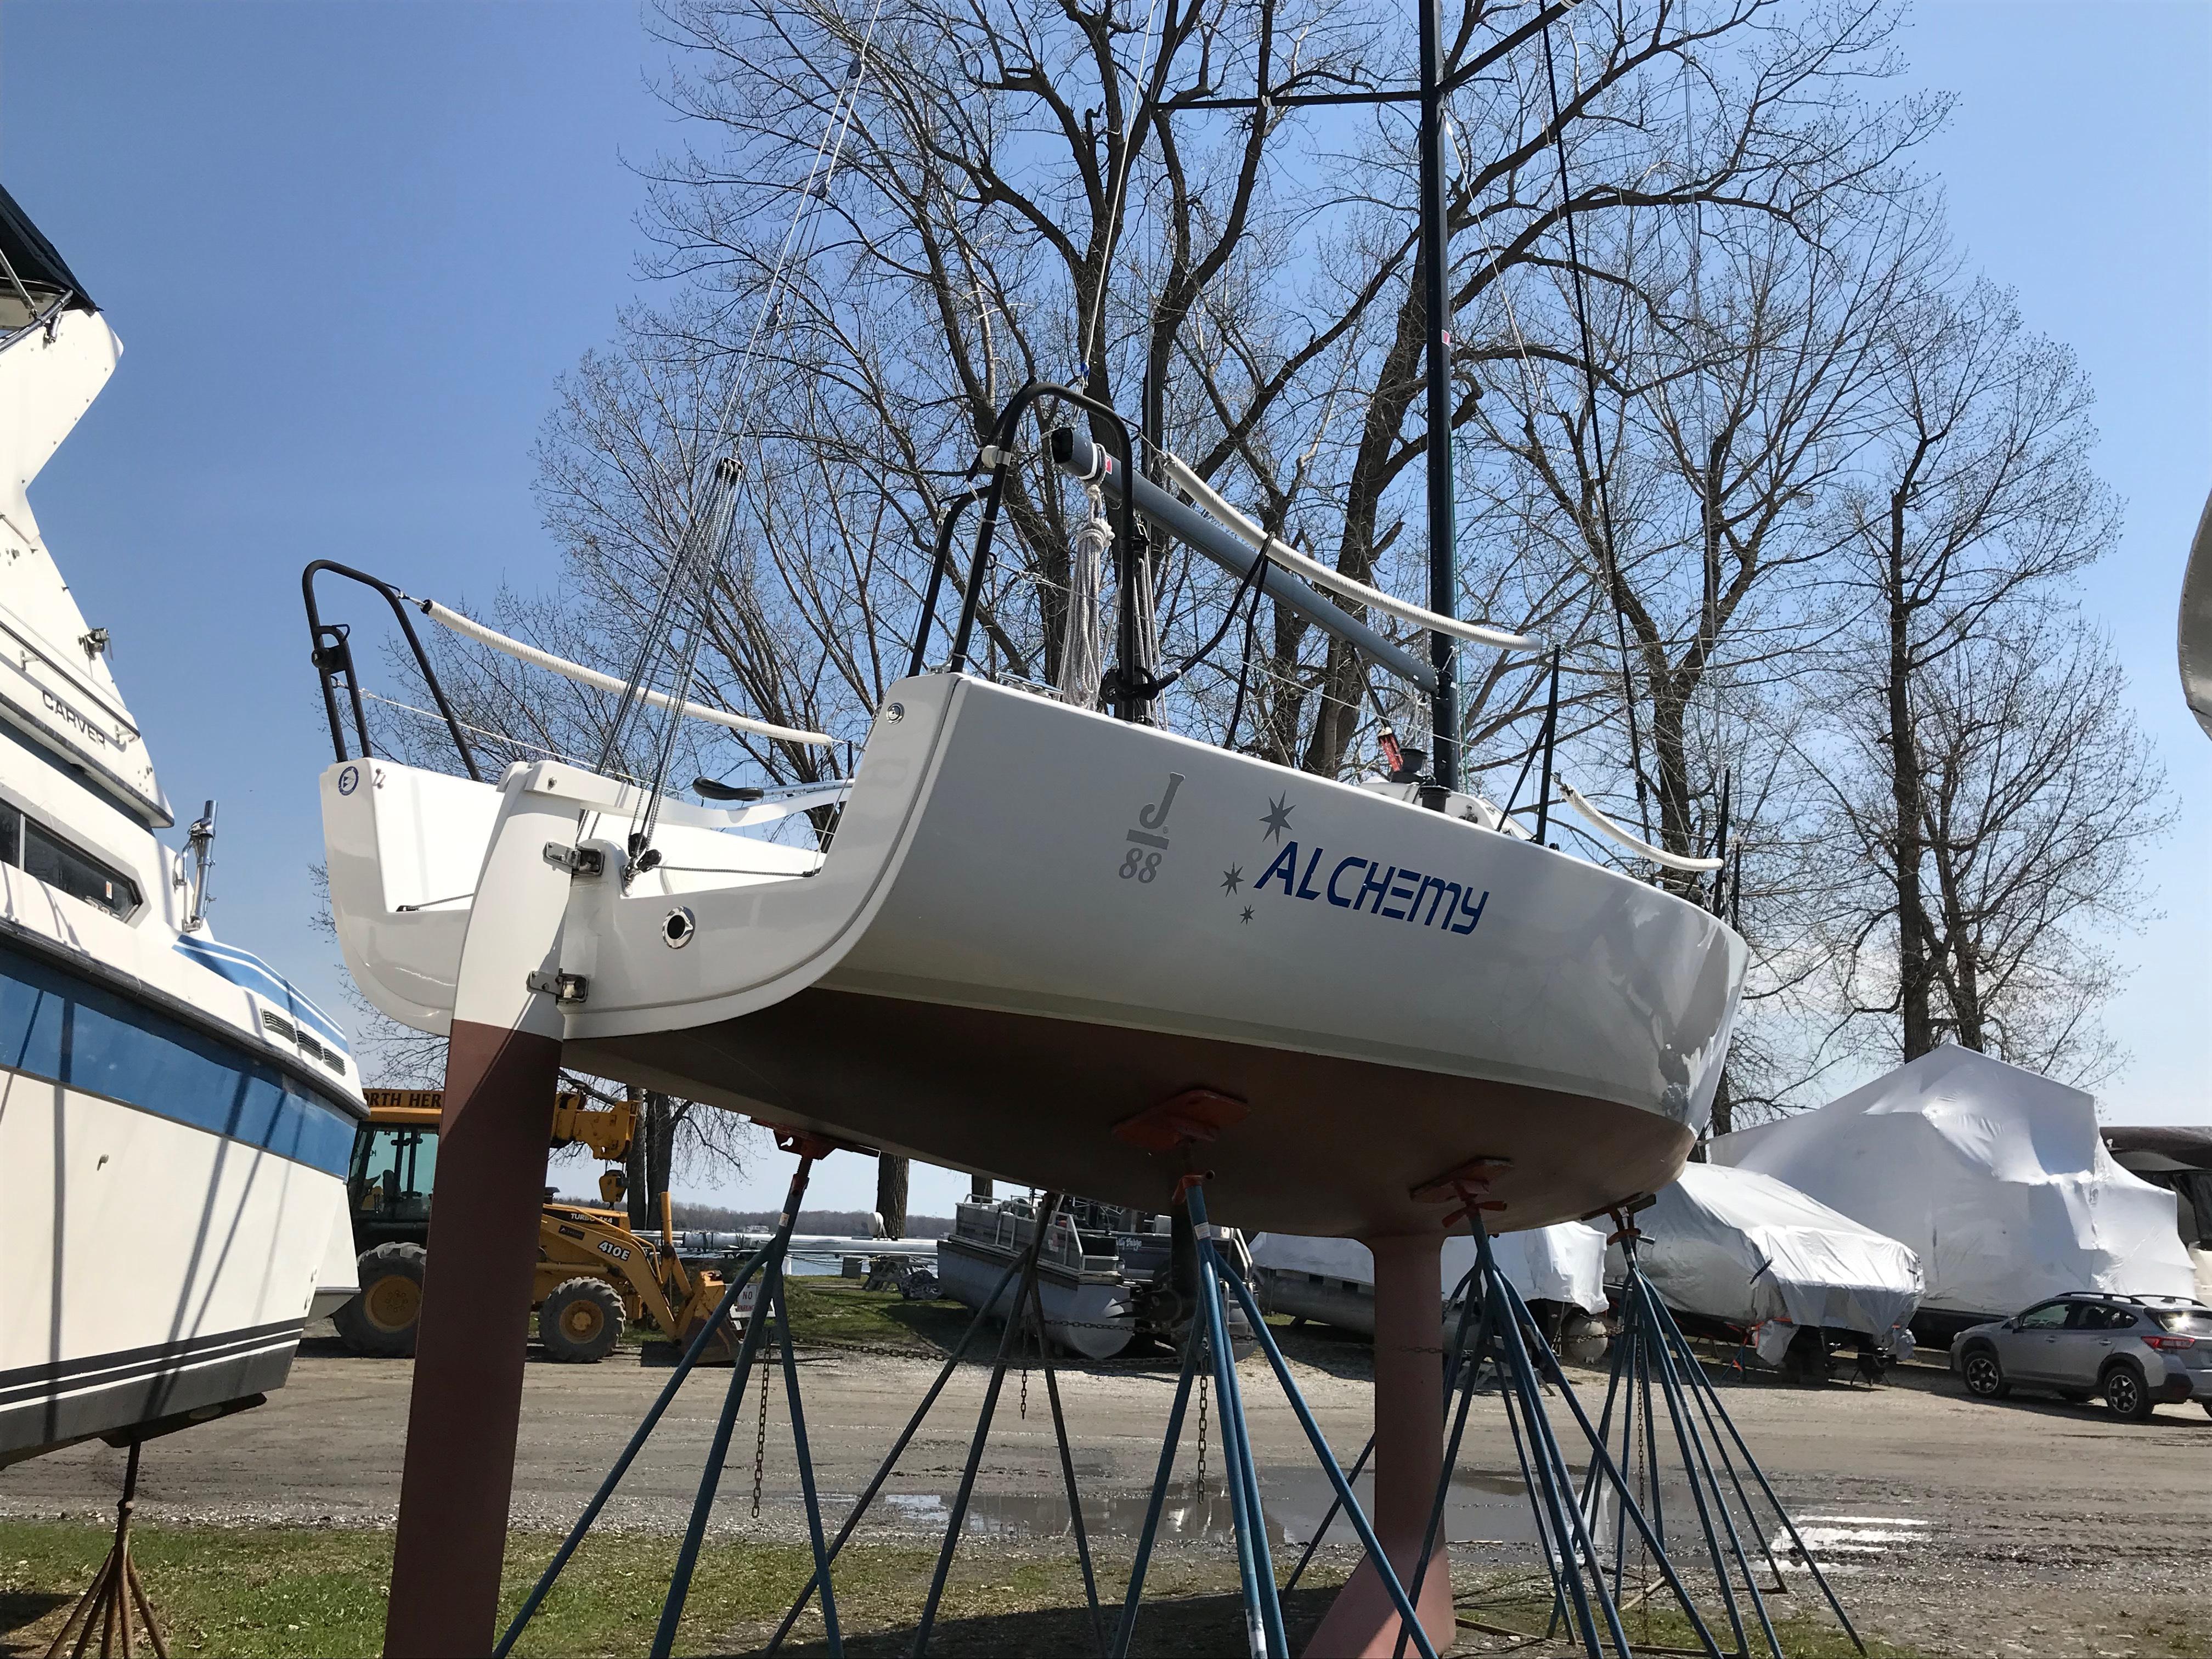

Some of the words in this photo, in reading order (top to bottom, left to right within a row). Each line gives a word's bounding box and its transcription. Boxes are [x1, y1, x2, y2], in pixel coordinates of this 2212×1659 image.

[42, 690, 106, 750] CARVER
[1139, 772, 1185, 830] J
[1119, 848, 1162, 883] 88
[363, 1092, 402, 1107] ORTH
[571, 1213, 596, 1222] TURBO
[599, 1241, 631, 1261] 410E
[742, 1291, 753, 1300] NO
